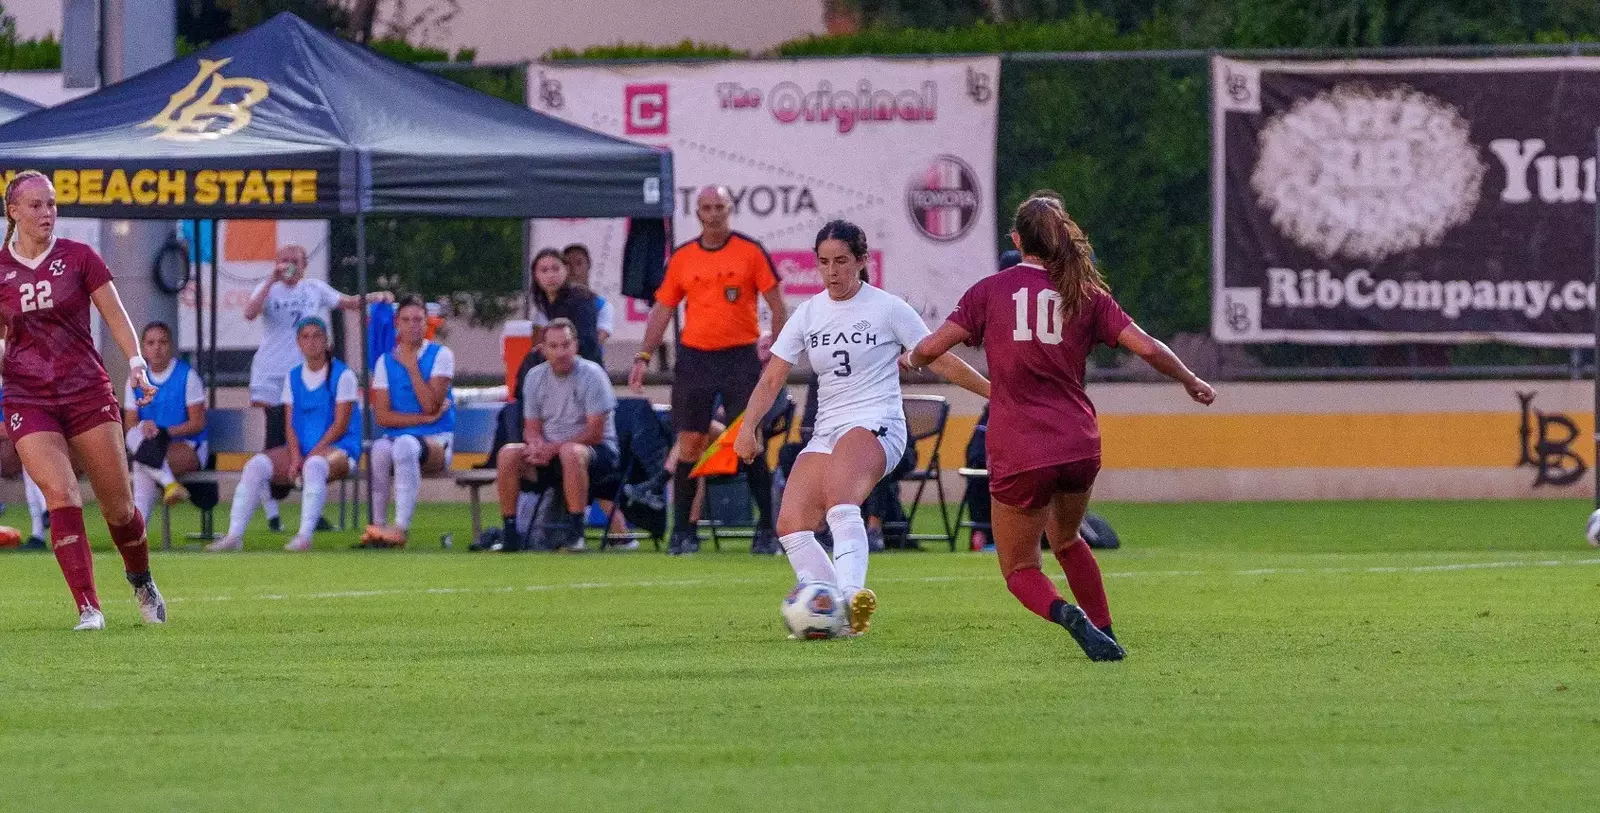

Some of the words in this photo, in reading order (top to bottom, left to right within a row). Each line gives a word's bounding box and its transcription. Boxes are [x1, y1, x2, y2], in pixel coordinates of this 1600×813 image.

[716, 82, 764, 109] The
[767, 78, 939, 134] Original
[53, 169, 187, 205] BEACH
[194, 169, 318, 204] STATE
[679, 185, 818, 217] TYOTA
[19, 279, 54, 313] 22
[1012, 287, 1064, 345] 10
[811, 331, 877, 348] BEACH
[832, 350, 851, 377] 3
